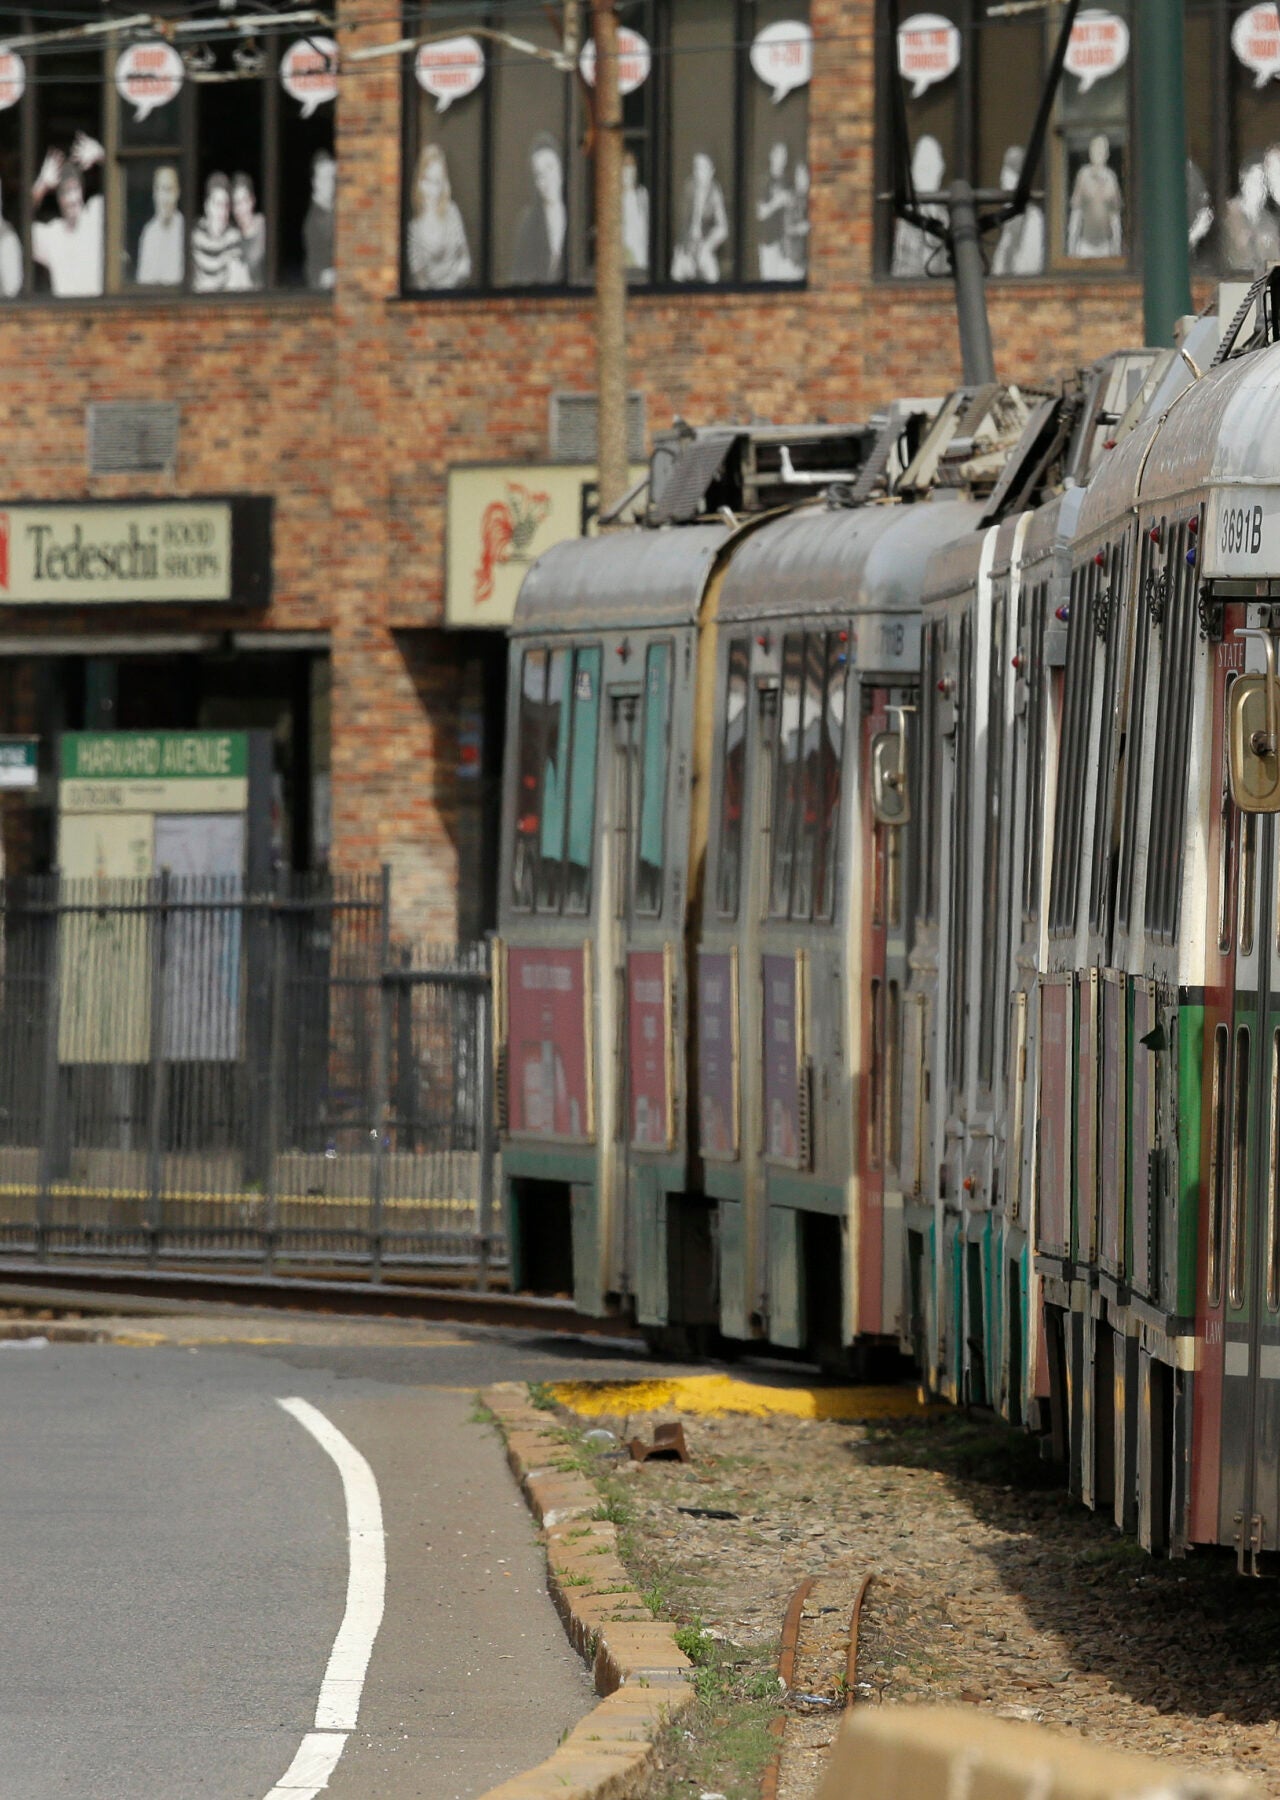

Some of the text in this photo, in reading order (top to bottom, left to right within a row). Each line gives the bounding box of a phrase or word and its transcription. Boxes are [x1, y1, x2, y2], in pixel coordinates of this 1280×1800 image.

[1221, 505, 1263, 554] 3691B
[26, 522, 158, 581] Tedeschi
[1218, 642, 1244, 668] STATE
[77, 736, 232, 774] HARVARD AVENUE
